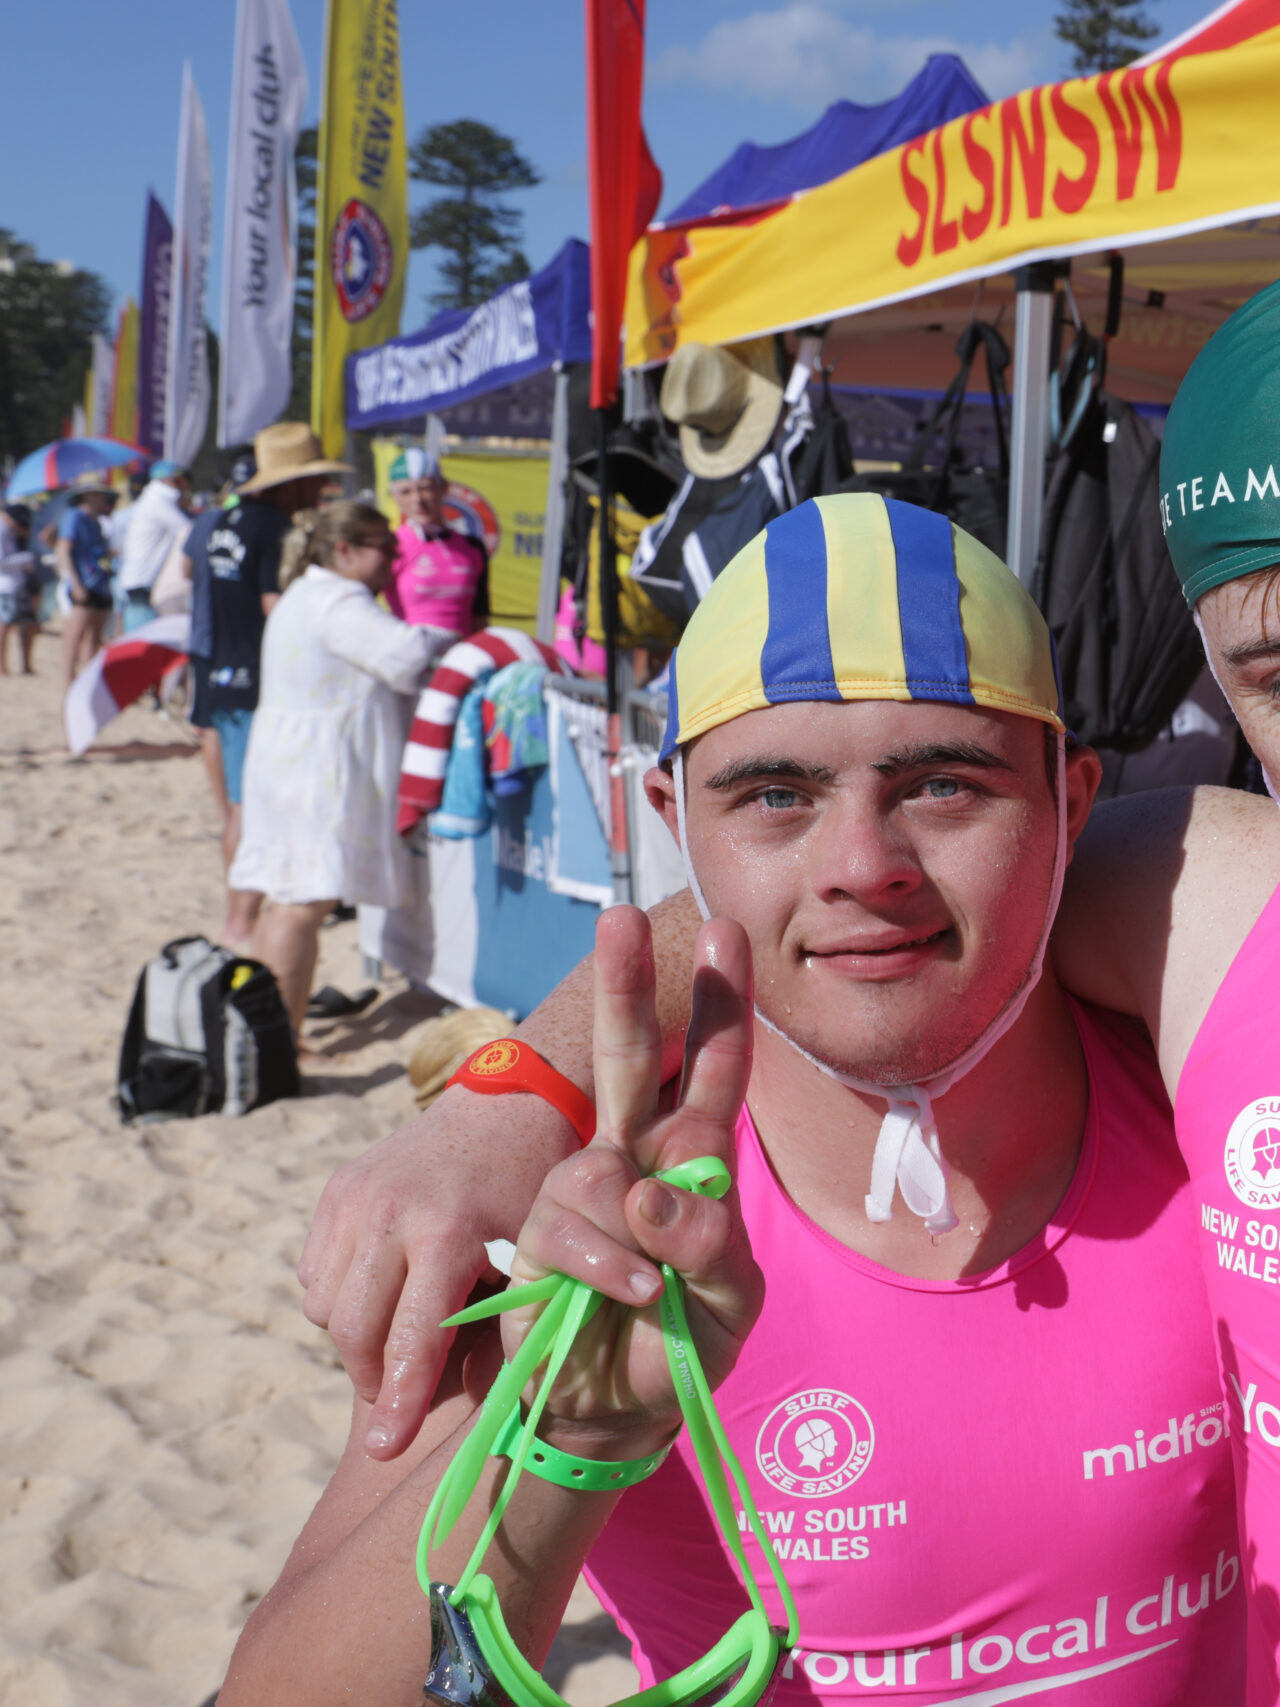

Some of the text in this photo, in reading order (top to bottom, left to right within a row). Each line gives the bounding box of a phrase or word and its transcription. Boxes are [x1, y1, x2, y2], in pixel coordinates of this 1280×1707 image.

[896, 57, 1182, 267] SLSNSW
[1177, 464, 1280, 516] TEAM
[1227, 1148, 1246, 1193] LIFE
[1201, 1203, 1239, 1240] NEW
[677, 1361, 697, 1399] OHANA
[785, 1393, 849, 1416] SURF
[1200, 1401, 1225, 1417] SINC
[760, 1440, 870, 1494] LIFE SAVING
[804, 1500, 907, 1533] SOUTH
[772, 1536, 870, 1561] WALES
[950, 1595, 1108, 1681] local
[1125, 1549, 1239, 1635] club
